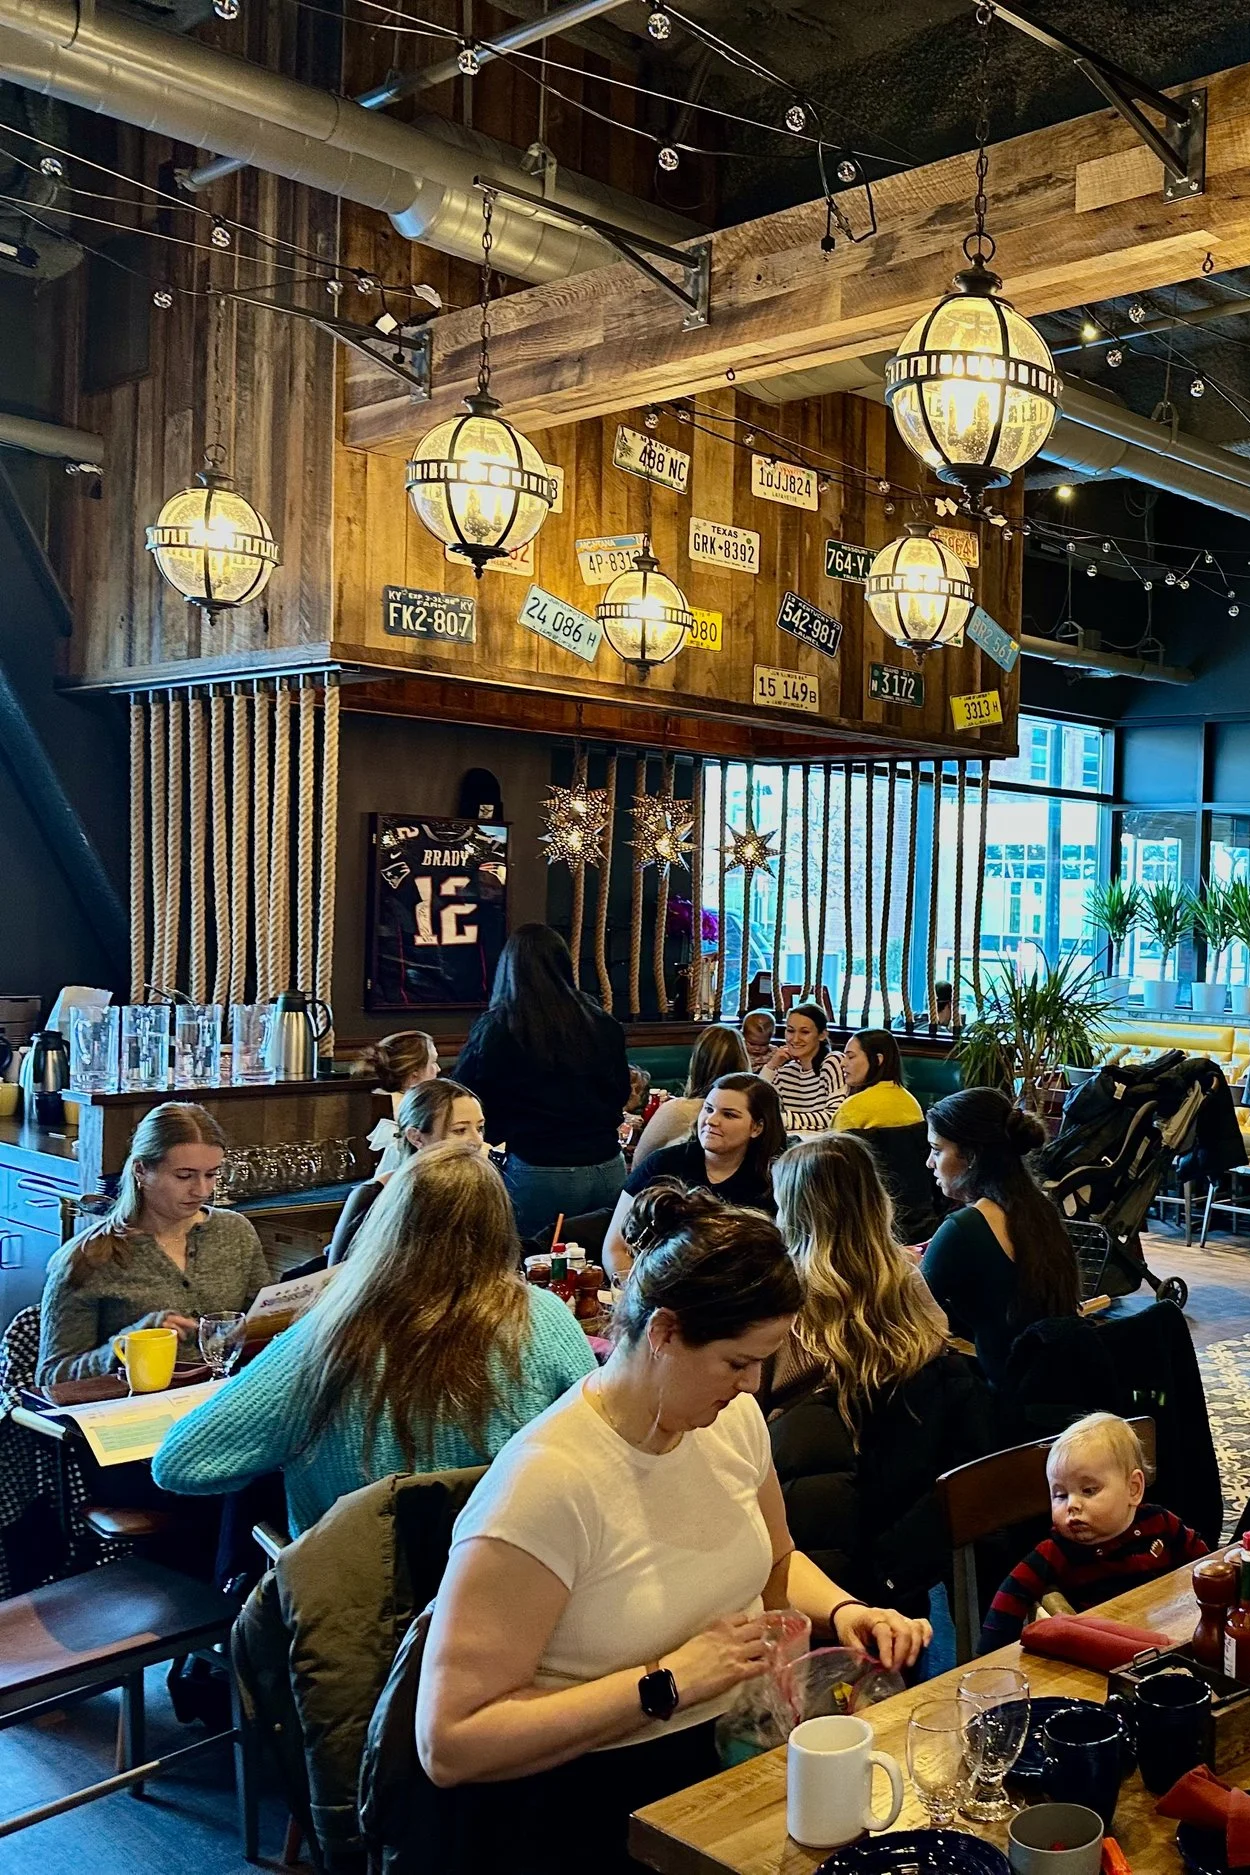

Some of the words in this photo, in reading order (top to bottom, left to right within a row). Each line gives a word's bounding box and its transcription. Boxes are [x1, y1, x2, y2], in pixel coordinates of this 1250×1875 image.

[669, 457, 686, 482] NC
[711, 525, 738, 539] TEXAS
[388, 590, 401, 601] KY
[460, 601, 474, 611] KY
[389, 602, 472, 638] FK2-807
[526, 596, 548, 624] 24
[552, 611, 584, 642] 086
[586, 631, 597, 648] H
[782, 601, 836, 649] 542-981
[759, 676, 776, 697] 15
[964, 699, 990, 720] 3313
[421, 849, 469, 867] BRADY
[413, 875, 479, 946] 12
